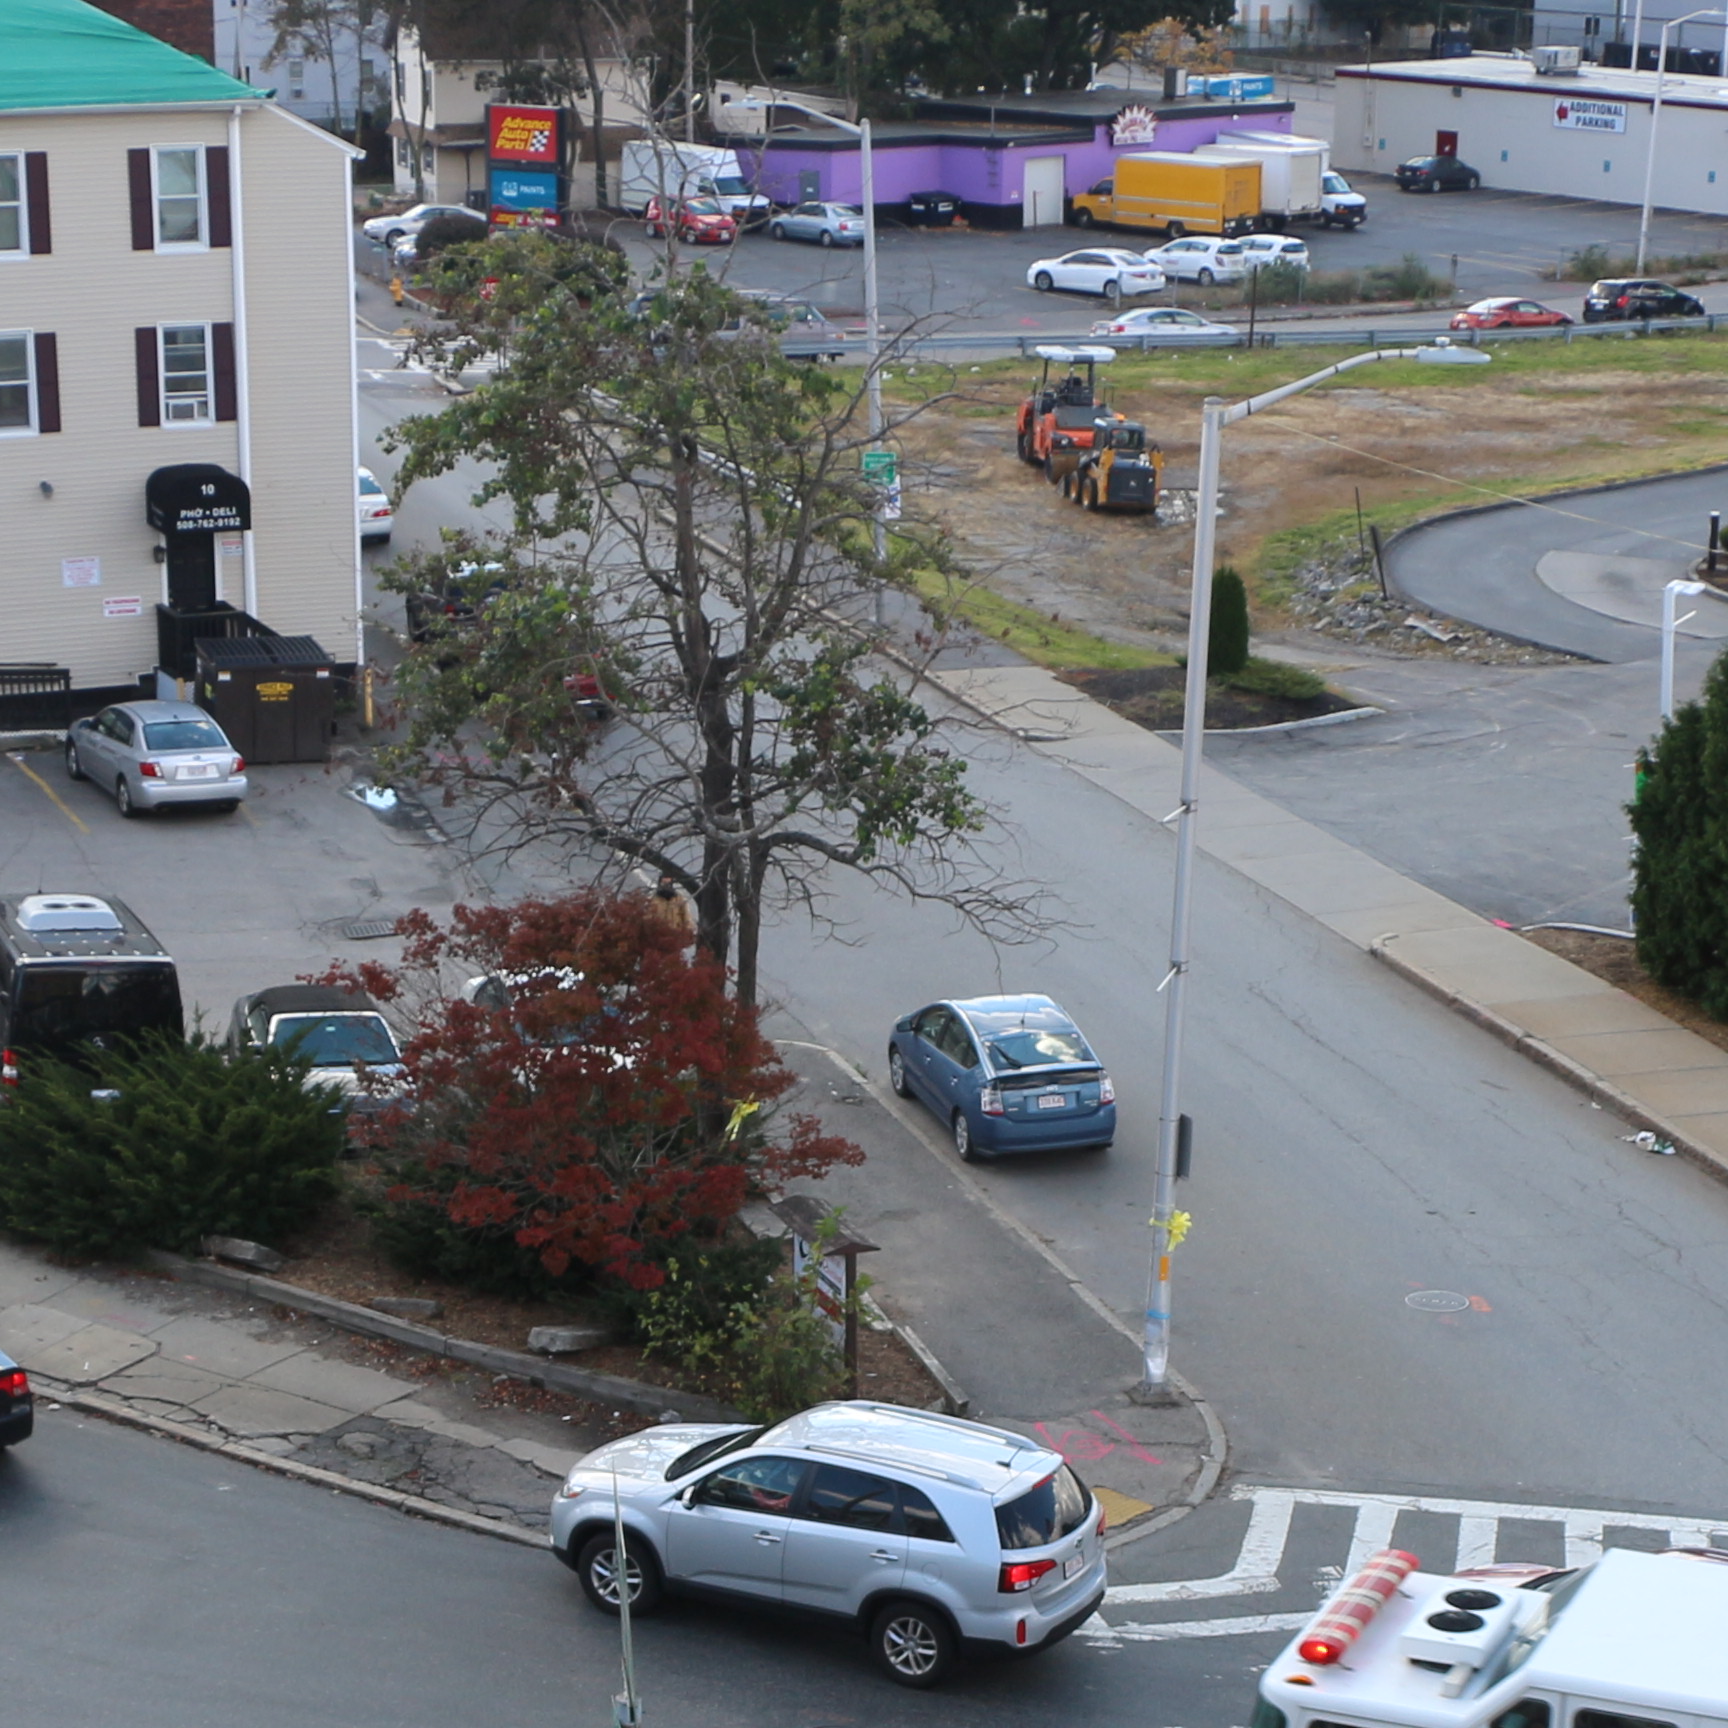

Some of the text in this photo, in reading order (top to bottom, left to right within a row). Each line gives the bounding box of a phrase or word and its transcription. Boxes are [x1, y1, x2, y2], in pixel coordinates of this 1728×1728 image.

[1569, 101, 1624, 117] ADDITIONAL
[501, 116, 553, 130] Advance
[1575, 115, 1617, 130] PARKING
[499, 127, 529, 140] Auto
[495, 138, 525, 150] Parts
[200, 483, 216, 496] 10
[212, 506, 237, 517] DELI
